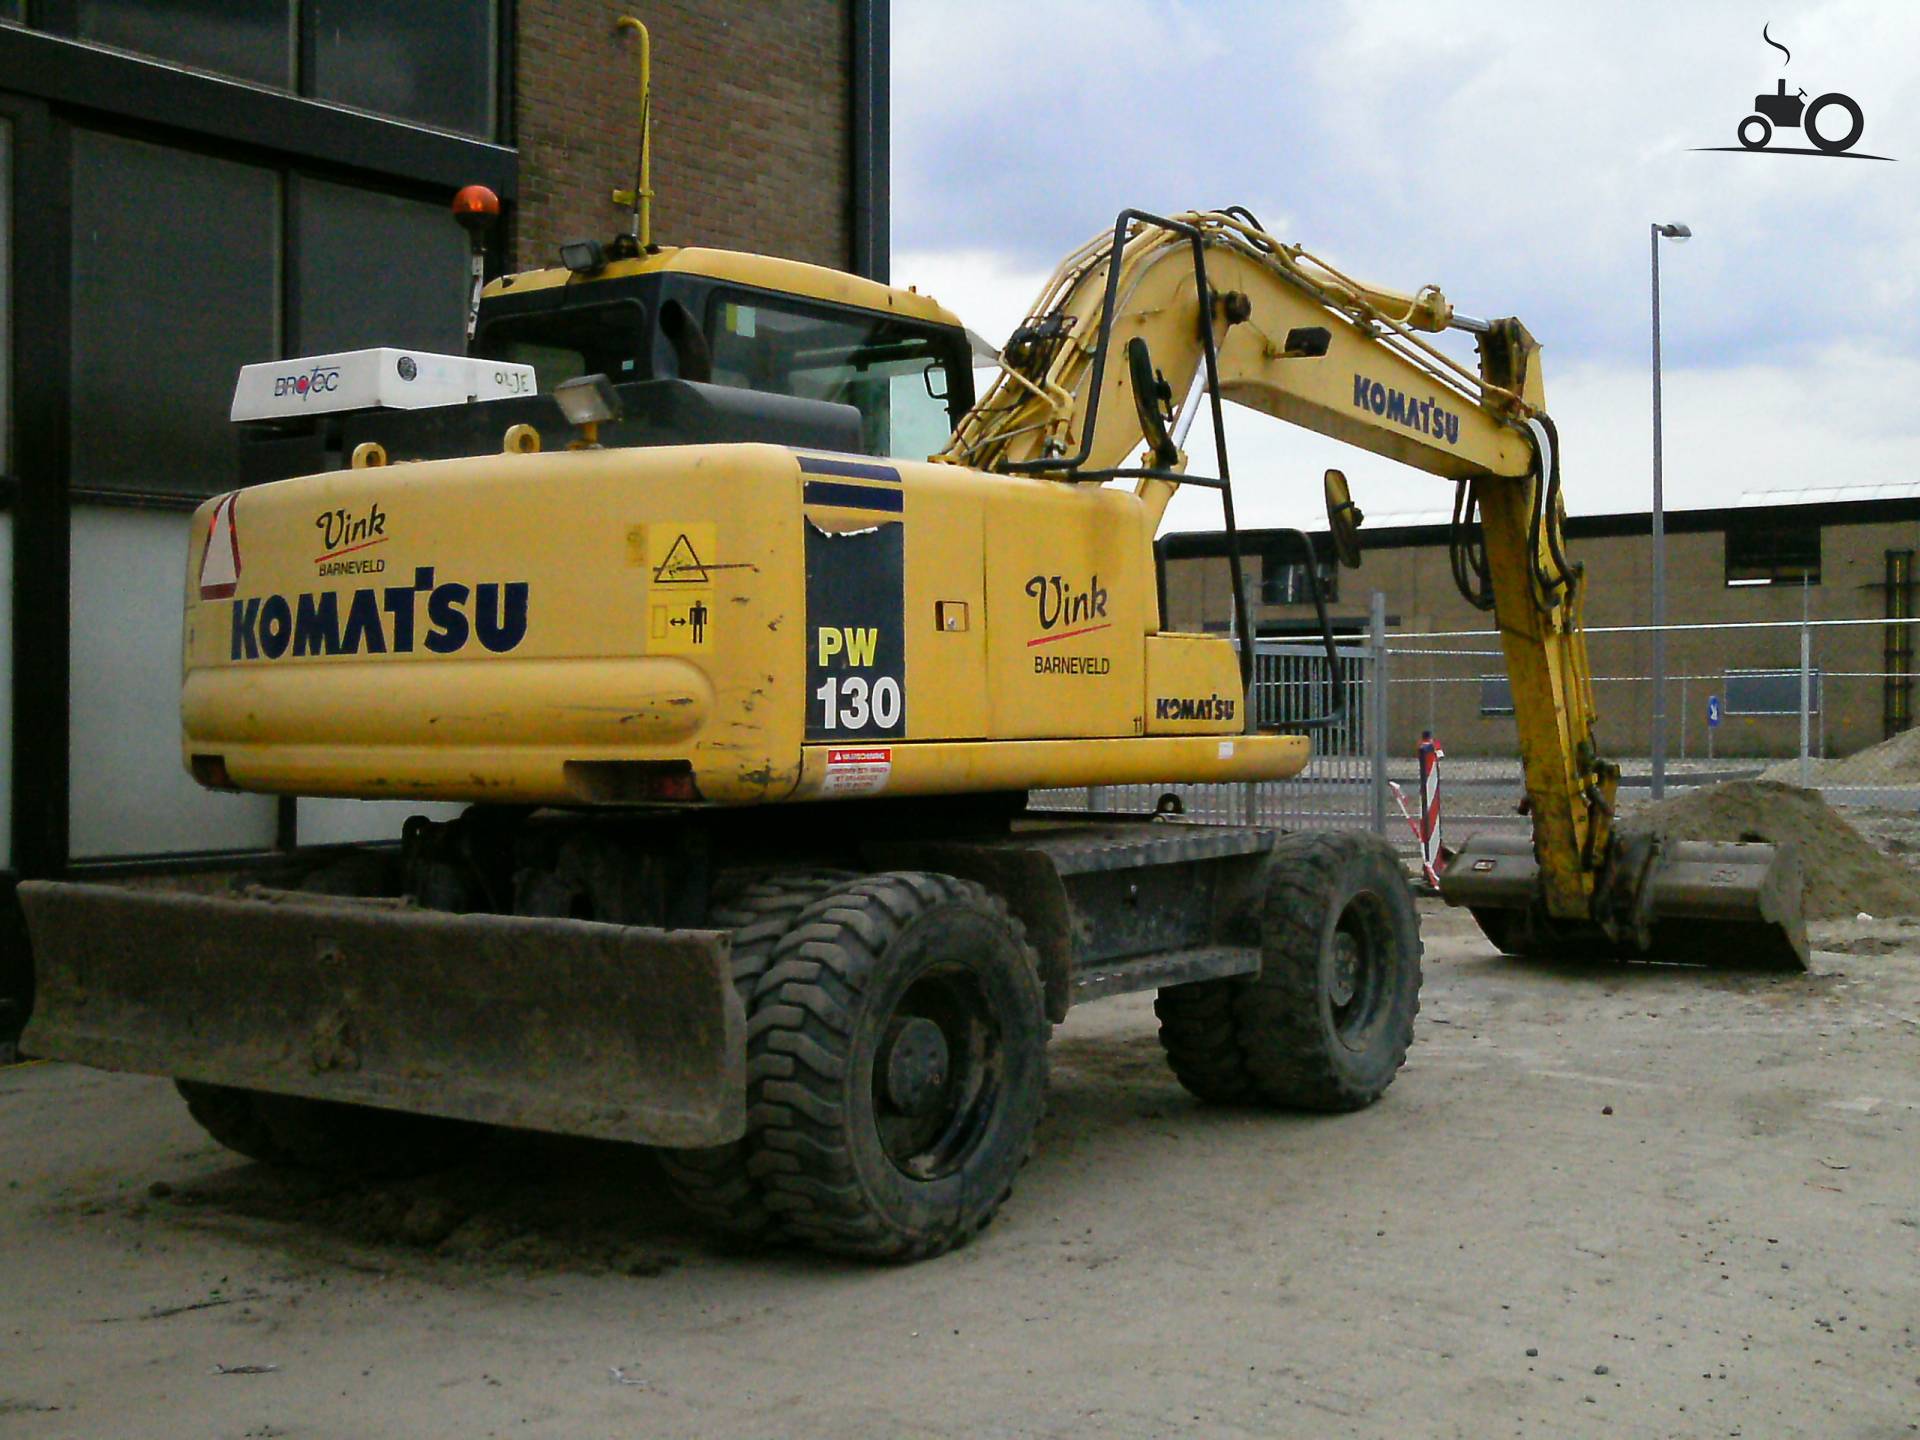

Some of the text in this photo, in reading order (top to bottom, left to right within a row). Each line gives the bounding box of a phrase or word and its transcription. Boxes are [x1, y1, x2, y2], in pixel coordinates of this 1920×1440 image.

[1353, 373, 1459, 445] KOMATSU
[315, 503, 386, 550] Vink
[319, 559, 385, 577] BARNEVELD
[231, 566, 529, 661] KOMATSU
[1025, 575, 1108, 630] Vink
[818, 626, 878, 667] PW
[1034, 656, 1110, 675] BARNEVELD
[816, 676, 901, 730] 130
[1156, 693, 1235, 720] KOMATSU
